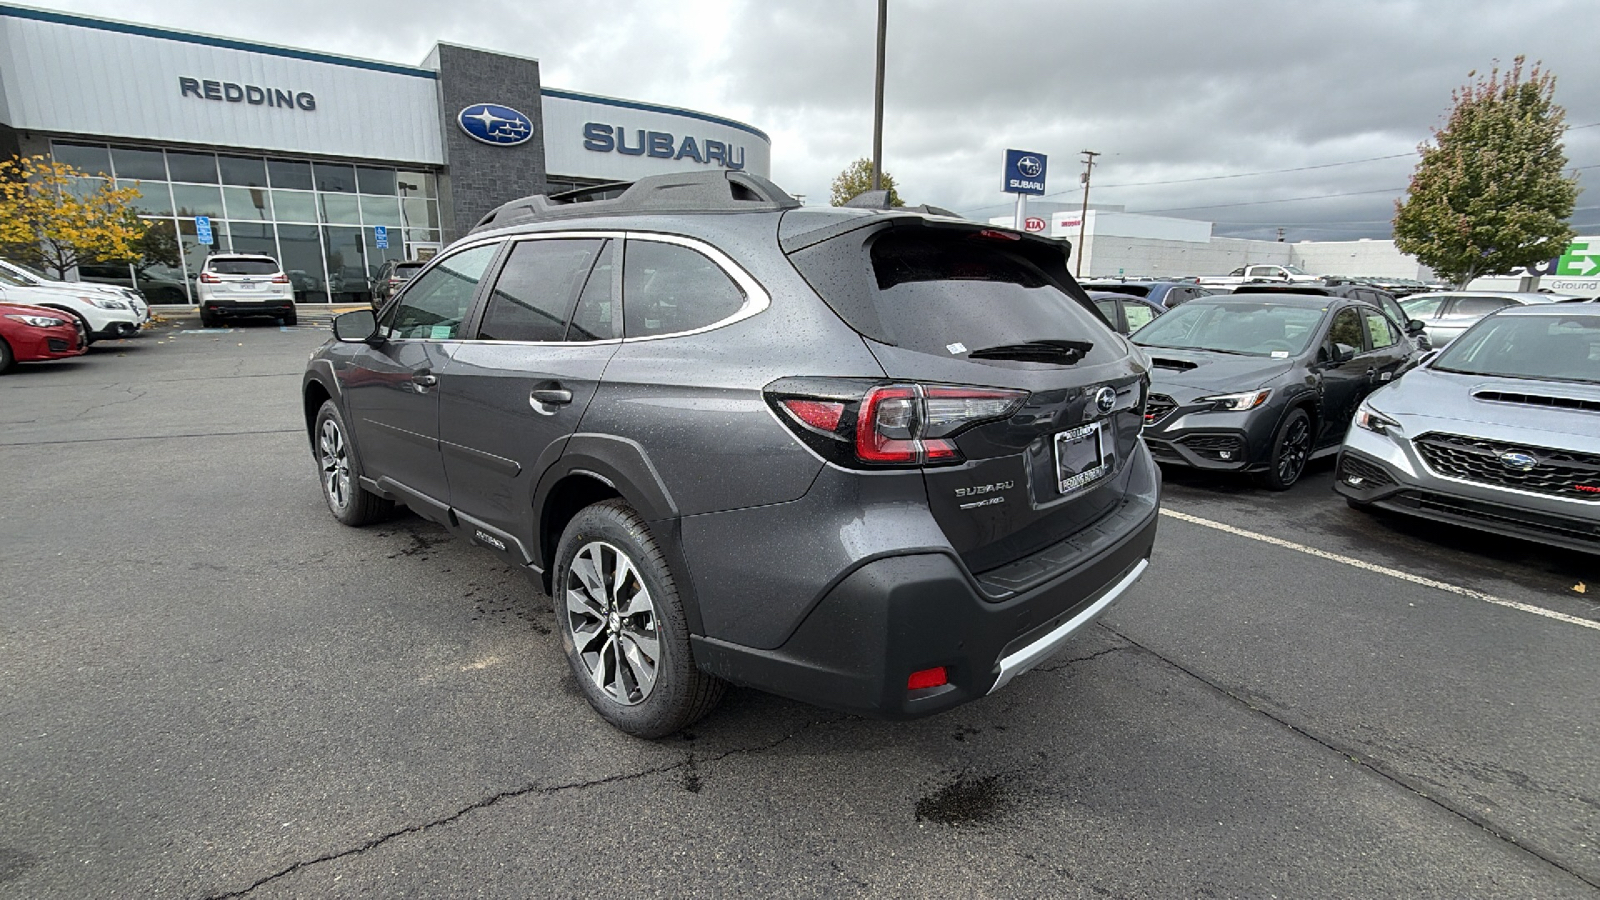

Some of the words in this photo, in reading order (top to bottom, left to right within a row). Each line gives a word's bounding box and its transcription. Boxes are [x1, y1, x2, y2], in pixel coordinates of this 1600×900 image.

[178, 76, 316, 111] REDDING
[583, 122, 745, 169] SUBARU
[1009, 179, 1044, 191] SUBARU
[1025, 220, 1042, 230] KIA
[1551, 281, 1598, 290] Ground
[954, 480, 1014, 497] SUBARU
